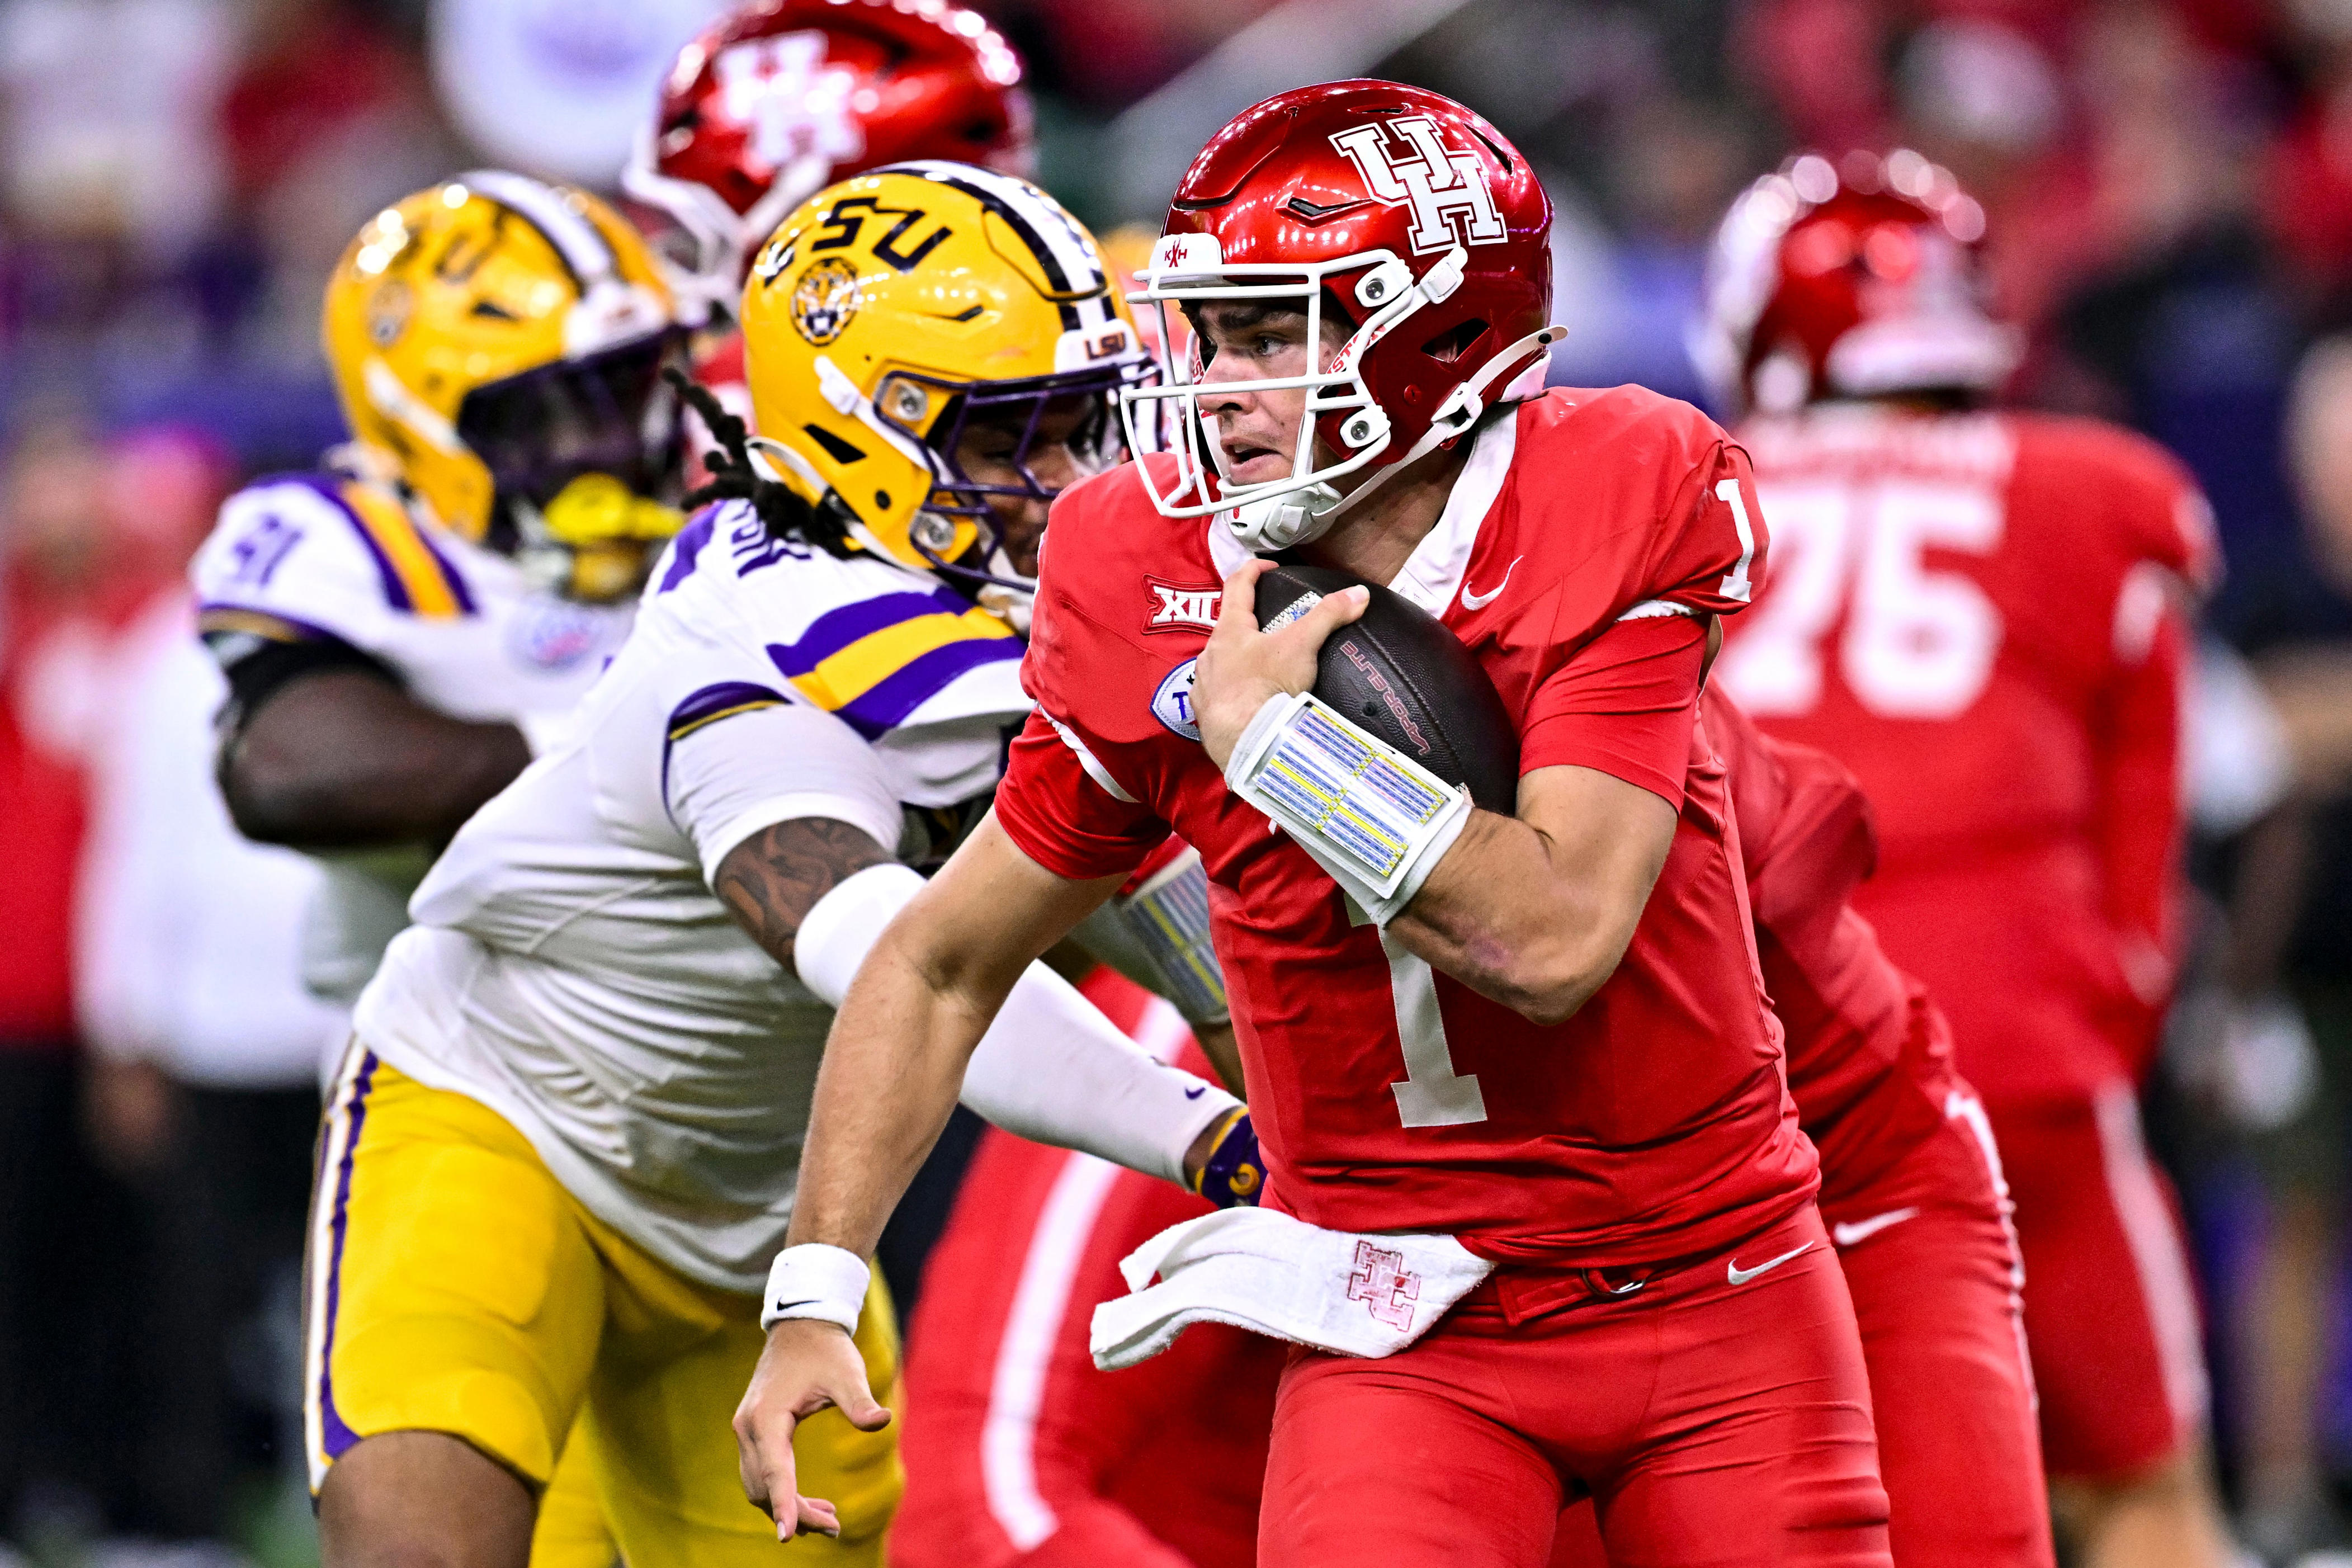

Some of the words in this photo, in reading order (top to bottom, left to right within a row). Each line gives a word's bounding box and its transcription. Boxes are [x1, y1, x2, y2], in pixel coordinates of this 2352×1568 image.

[1328, 114, 1509, 256] UH
[1084, 330, 1126, 360] LSU
[1715, 478, 1751, 603] 1
[1152, 585, 1222, 627] XII
